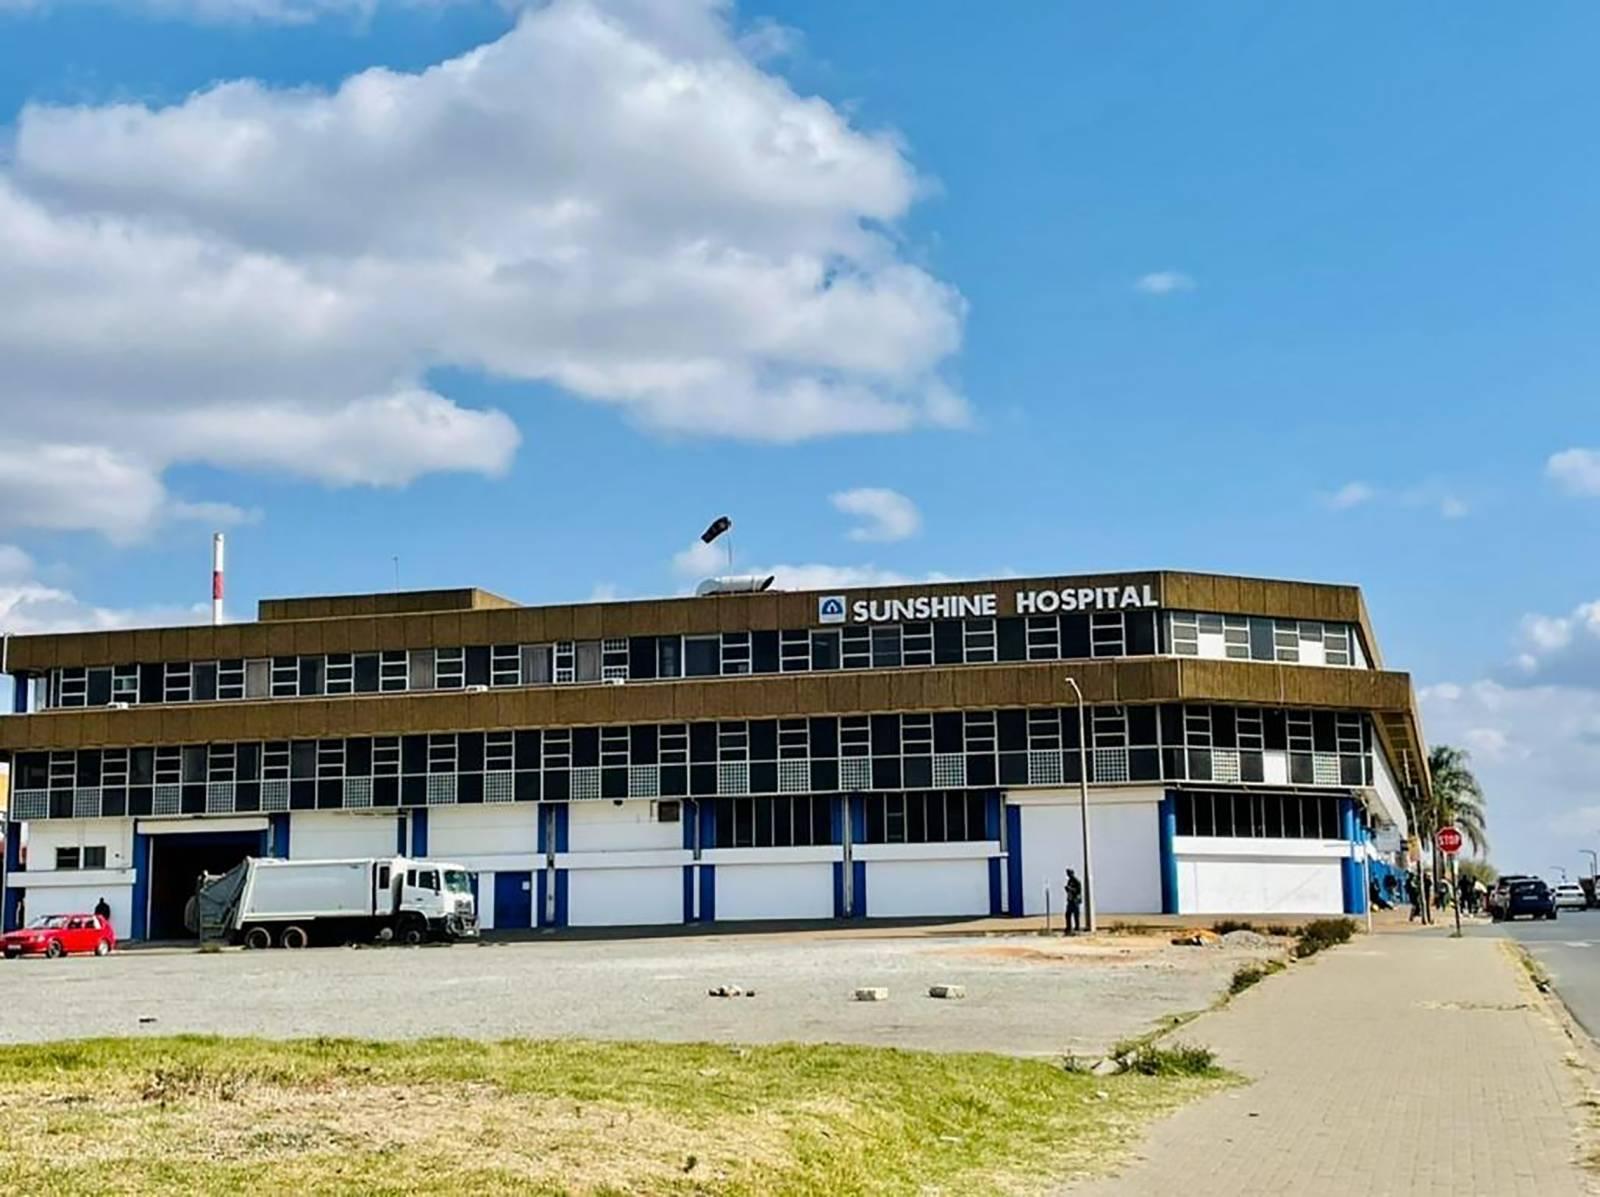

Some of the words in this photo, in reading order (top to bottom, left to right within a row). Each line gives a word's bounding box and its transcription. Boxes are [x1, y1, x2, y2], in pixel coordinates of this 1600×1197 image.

[853, 594, 996, 622] SUNSHINE
[1016, 585, 1159, 614] HOSPITAL
[1438, 833, 1460, 846] STOP
